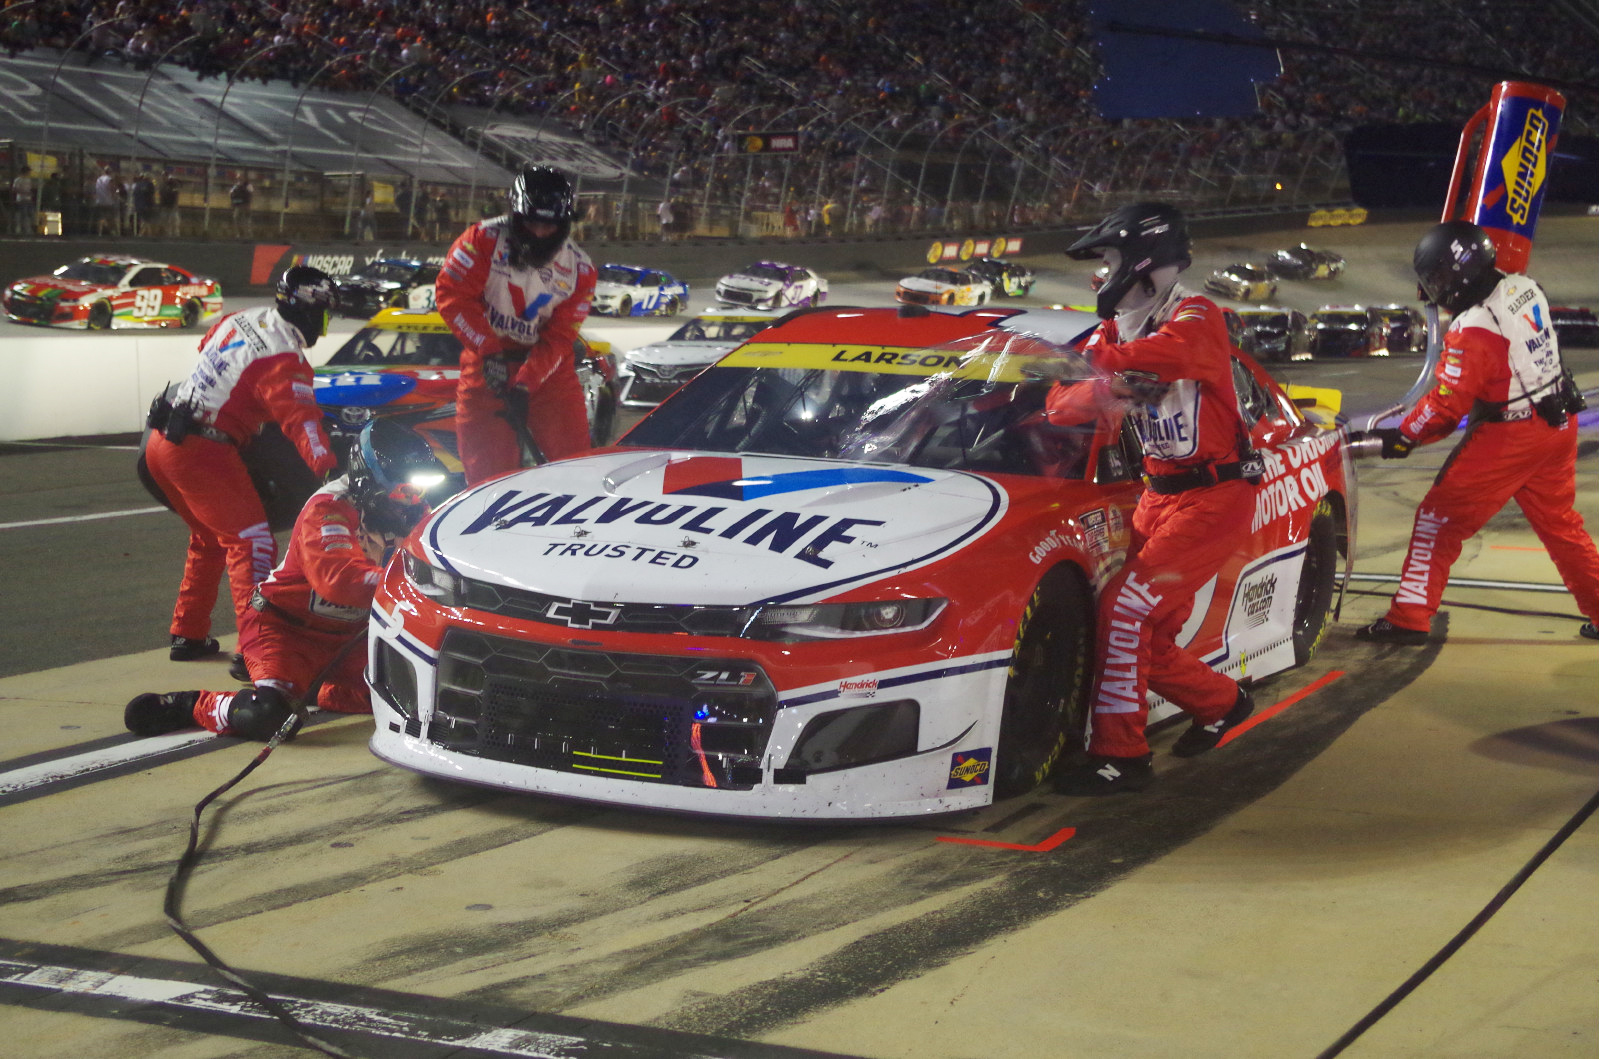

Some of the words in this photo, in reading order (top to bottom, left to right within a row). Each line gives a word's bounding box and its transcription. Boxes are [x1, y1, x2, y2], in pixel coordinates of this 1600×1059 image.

[1509, 110, 1546, 221] SUNOCO
[308, 255, 354, 275] NASCAR
[133, 289, 162, 317] 99
[642, 291, 660, 310] 17
[1508, 288, 1537, 315] HARDER
[831, 350, 967, 370] LARSON
[1251, 474, 1307, 534] MOTOR
[1300, 461, 1329, 502] OIL
[542, 543, 699, 570] TRUSTED
[1396, 507, 1449, 605] VALVOLINE
[1241, 573, 1278, 613] Hendrick
[1095, 571, 1164, 714] VALVOLINE
[691, 670, 757, 686] ZL1
[838, 679, 879, 693] Hendrick
[952, 761, 988, 777] SUNOCO
